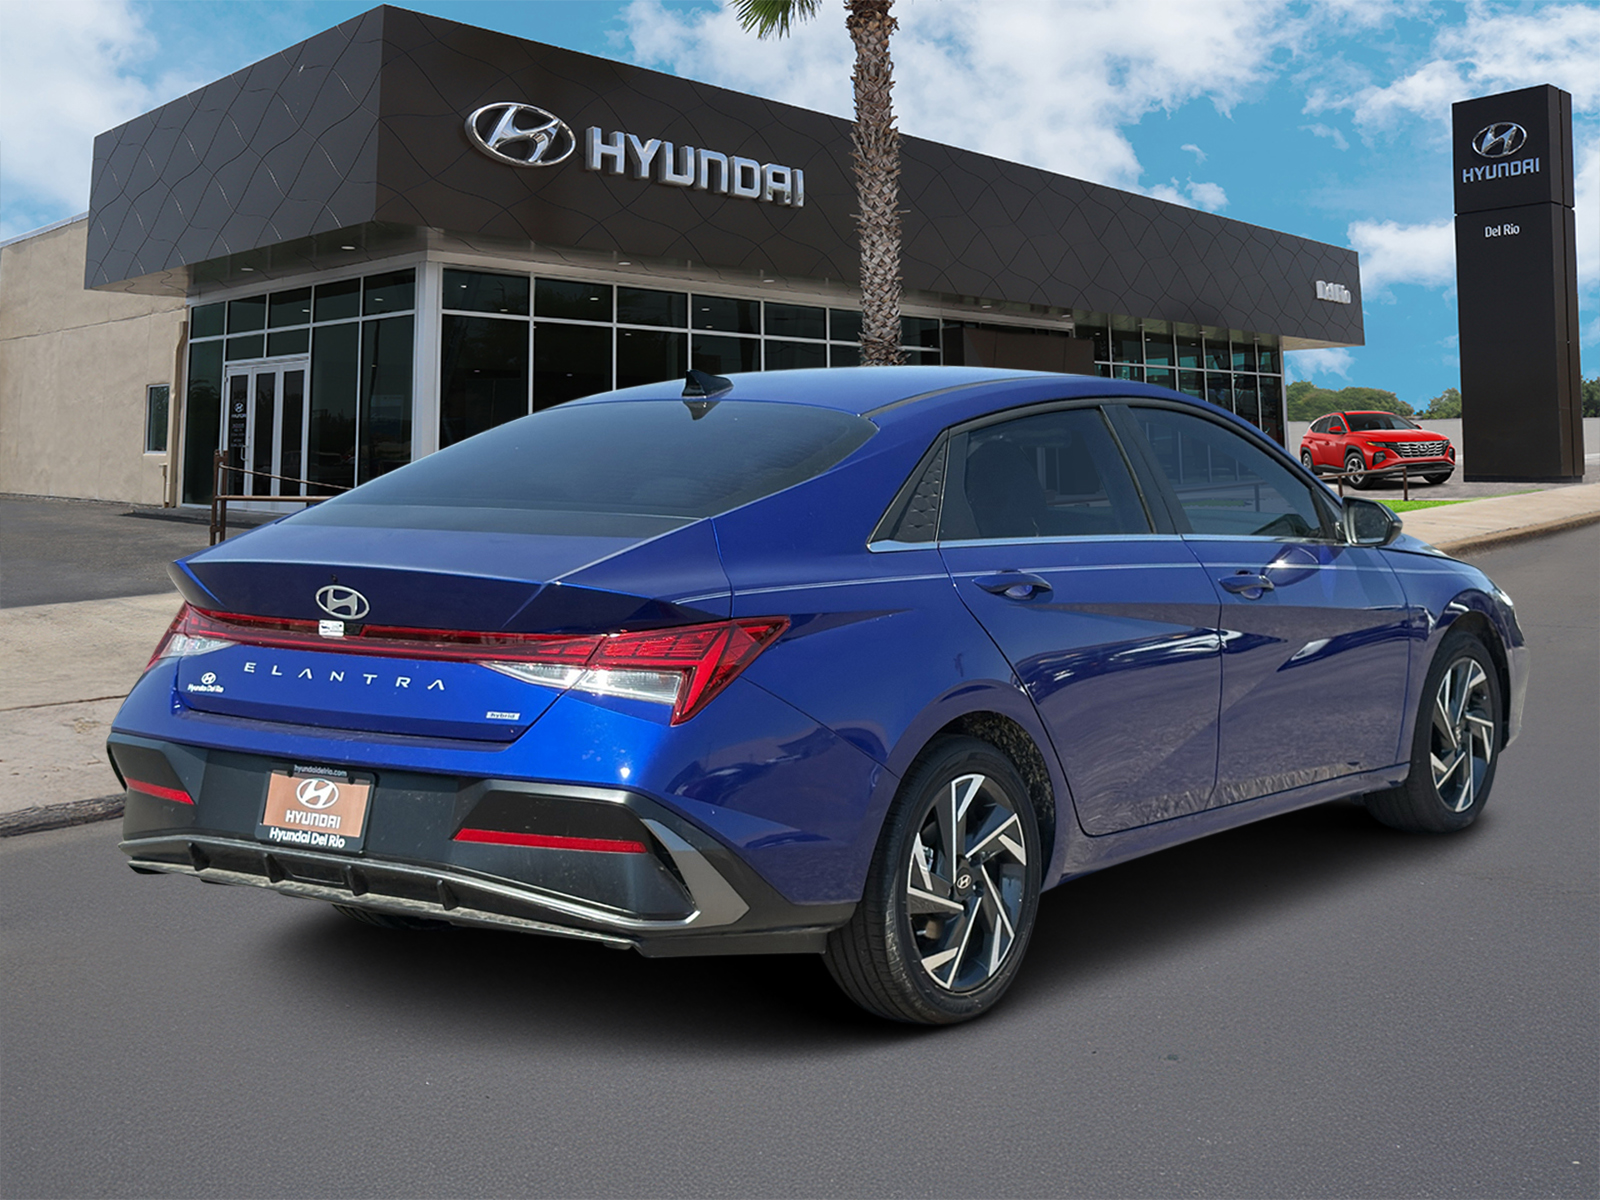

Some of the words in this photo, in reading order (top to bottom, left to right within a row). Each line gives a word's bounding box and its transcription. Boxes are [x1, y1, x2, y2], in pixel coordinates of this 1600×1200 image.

[585, 126, 805, 207] HYUNDAI
[1462, 157, 1540, 183] HYUNDAI
[1484, 225, 1501, 238] Del
[1503, 223, 1520, 235] Rio
[243, 661, 446, 691] ELANTRA
[294, 764, 347, 777] hyundaidelrio.com
[285, 809, 341, 829] HYUNDAI
[269, 827, 311, 842] Hyundai
[311, 831, 328, 847] Del
[328, 834, 345, 848] Rio
